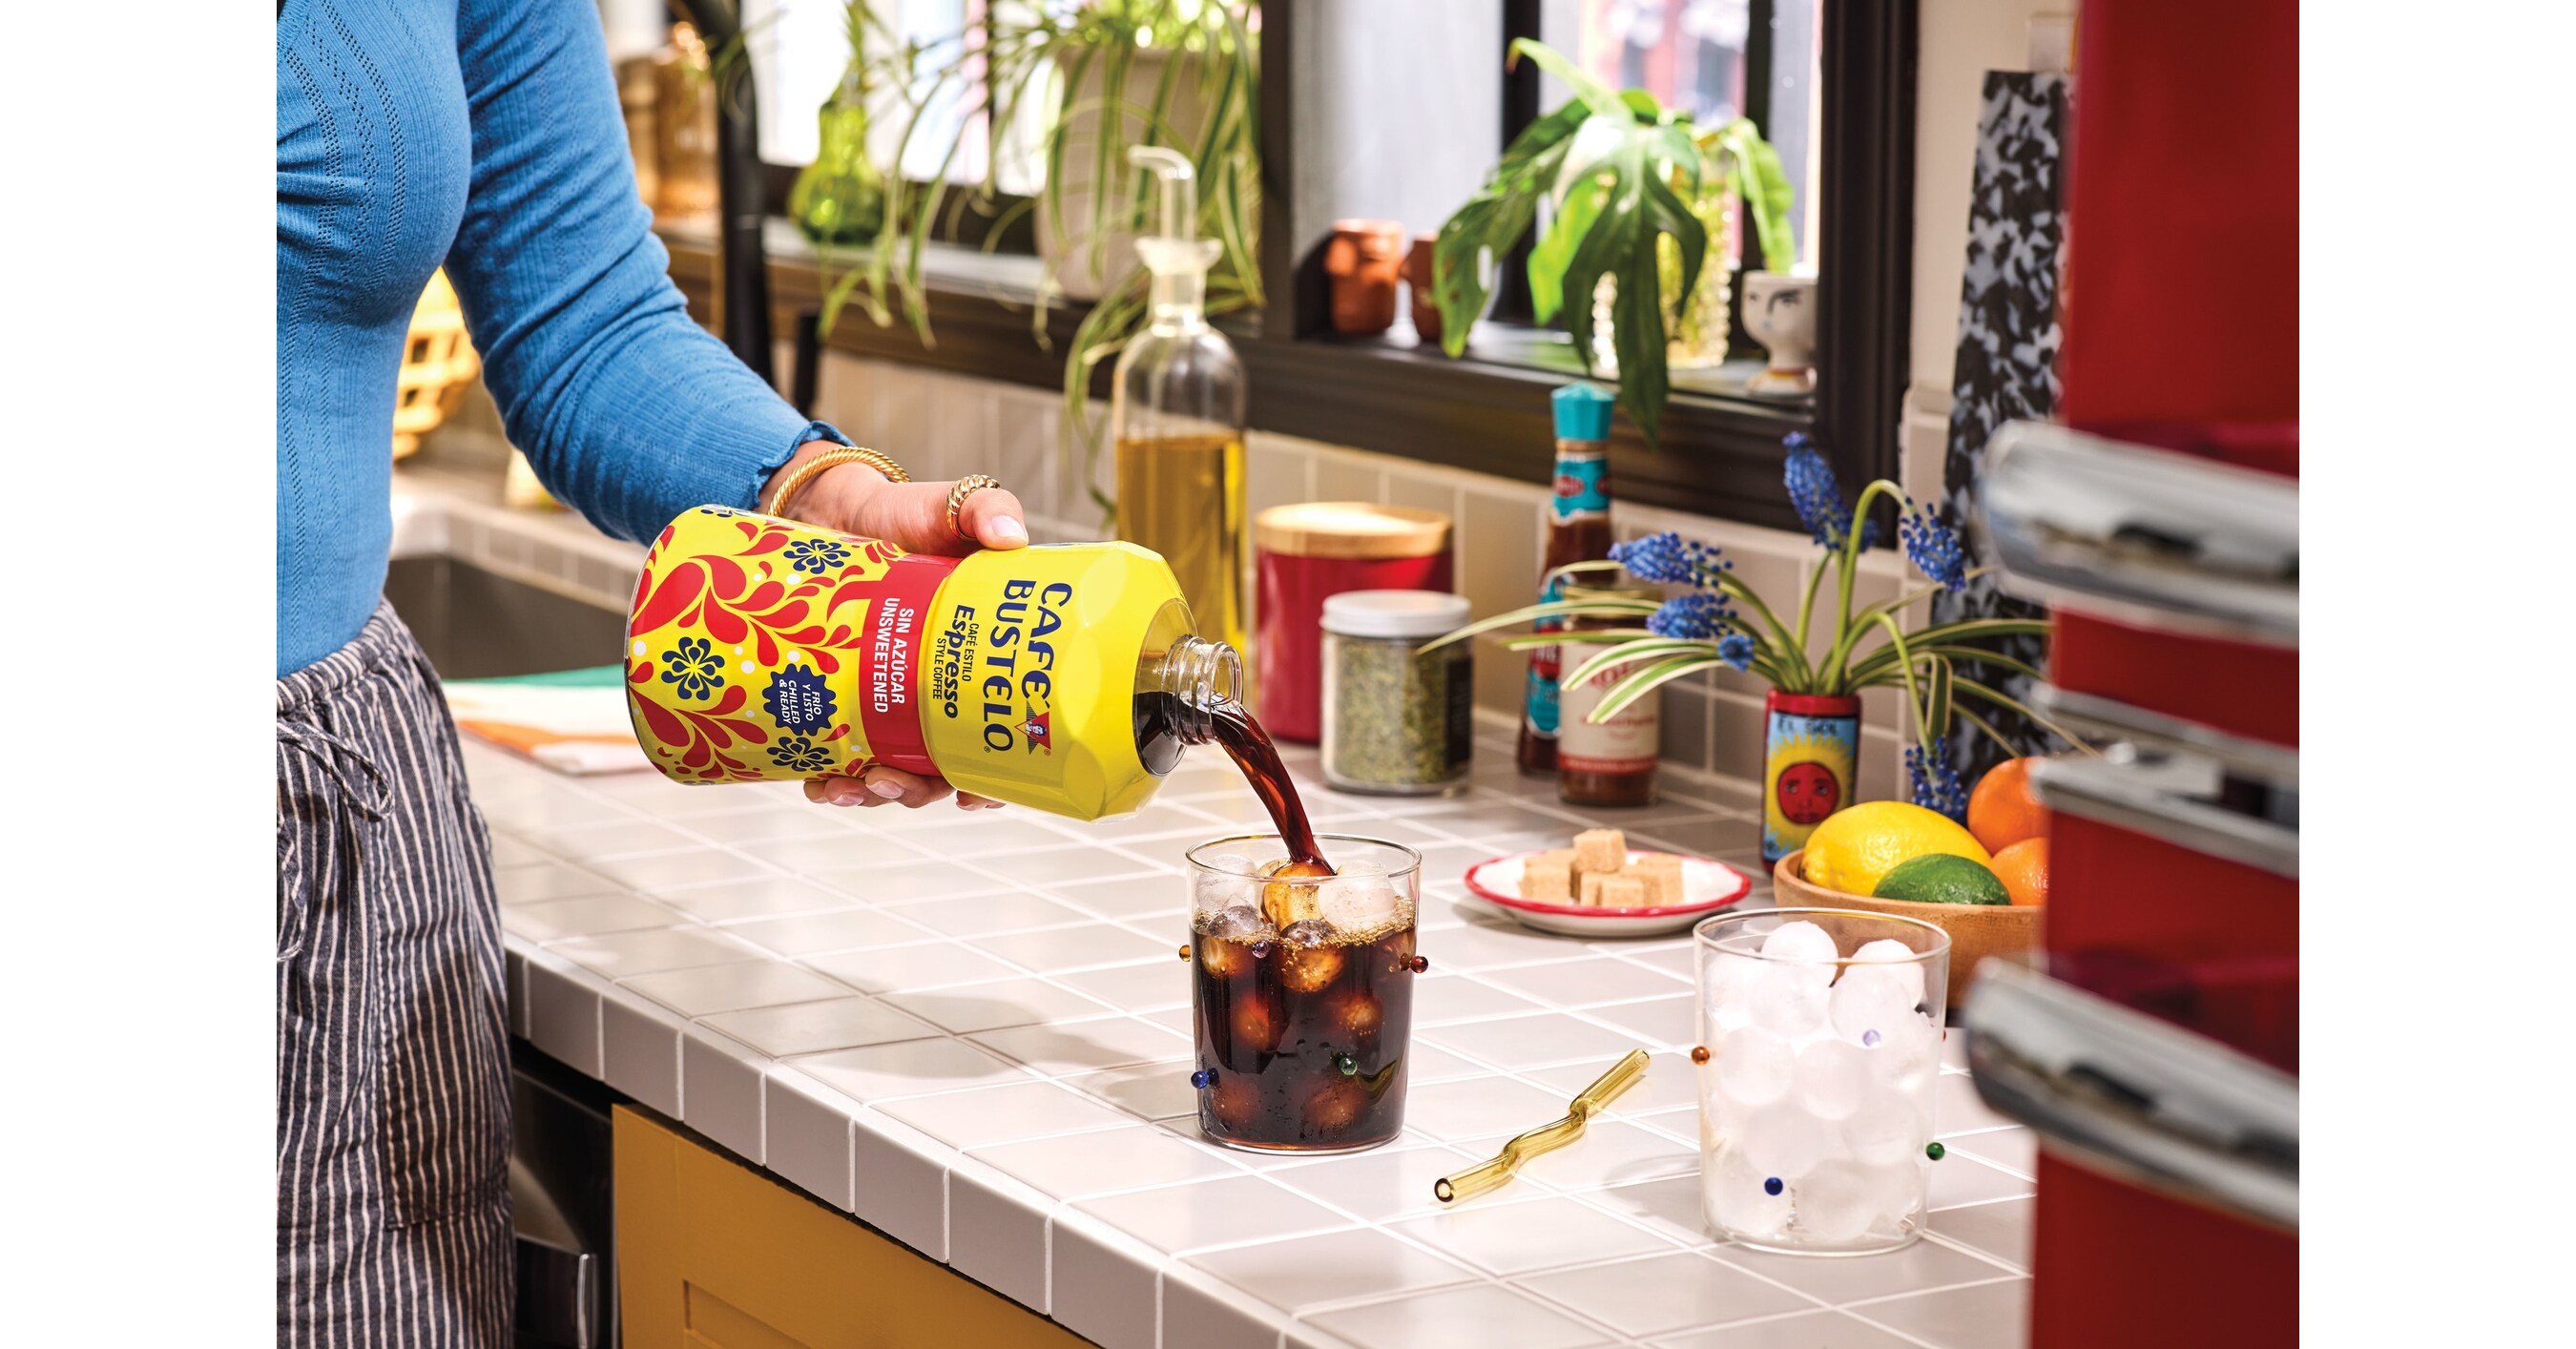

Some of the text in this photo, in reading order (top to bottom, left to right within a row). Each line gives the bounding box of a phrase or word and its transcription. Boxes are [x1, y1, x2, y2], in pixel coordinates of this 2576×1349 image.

[873, 597, 901, 713] UNSWEETENED
[890, 608, 914, 704] SIN AZÚCAR
[932, 637, 946, 700] STYLE COFFEE
[944, 604, 975, 719] Espresso
[962, 623, 979, 682] CAFÉ ESTILO
[983, 579, 1037, 752] BUSTELO
[1021, 582, 1072, 709] CAFÉ
[779, 678, 792, 724] & READY
[788, 679, 800, 724] CHILLED
[802, 693, 814, 721] LISTO
[812, 691, 823, 716] FRÍO
